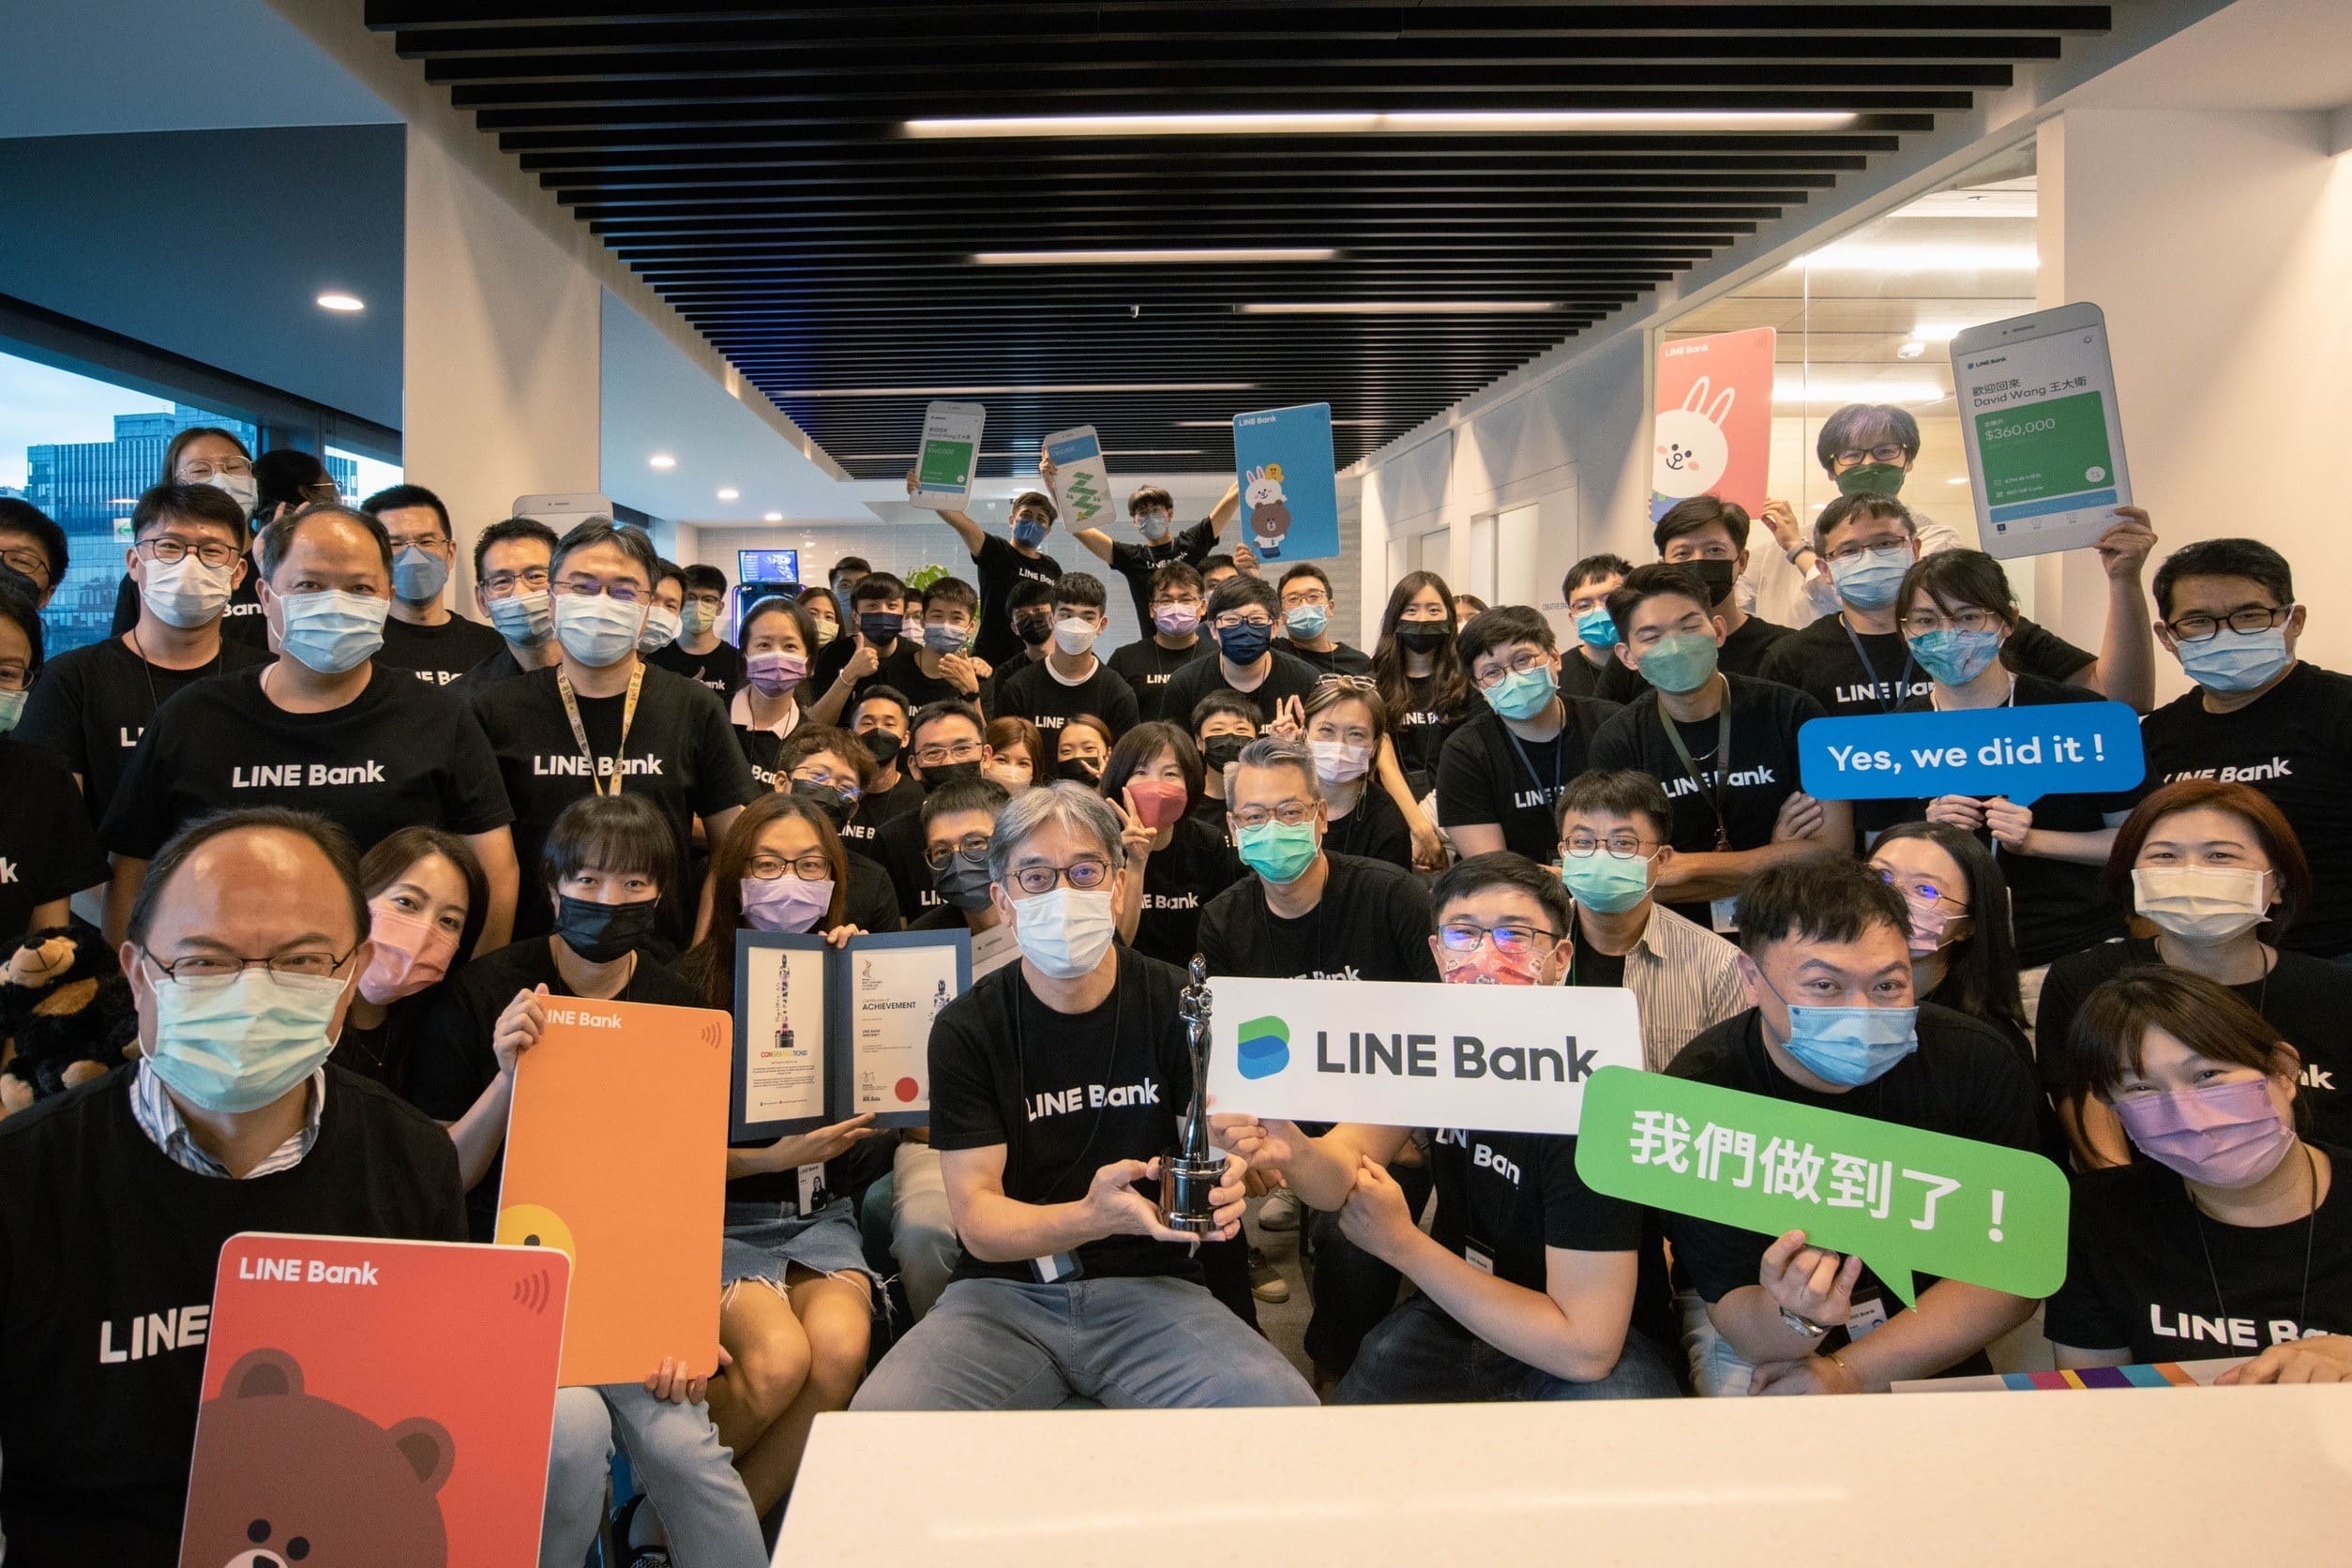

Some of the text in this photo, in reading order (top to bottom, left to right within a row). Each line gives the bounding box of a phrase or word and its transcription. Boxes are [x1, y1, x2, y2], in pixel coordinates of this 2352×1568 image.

[1665, 343, 1711, 357] LINE Bank
[1991, 356, 2007, 365] Bank
[1972, 378, 2021, 397] 歡迎回來
[1973, 376, 2088, 408] David Wang 王大衛
[1238, 415, 1276, 427] LINE Bank
[1984, 418, 2056, 442] $360,000
[1018, 567, 1055, 586] LINE Ban
[1402, 712, 1425, 726] INE
[534, 755, 593, 776] LINE
[1827, 733, 2104, 775] Yes, we did it !
[232, 760, 385, 788] LINE Bank
[1713, 764, 1776, 787] ank
[2220, 756, 2293, 784] Bank
[837, 824, 865, 839] INE
[1154, 892, 1199, 910] Bank
[862, 1002, 916, 1011] ACHIEVEMENT
[546, 1009, 623, 1029] INE Bank
[1317, 1031, 1600, 1083] LINE Bank
[1025, 1077, 1161, 1123] LINE Bank
[1473, 1142, 1521, 1185] Ban
[1629, 1109, 2004, 1243] 我們做到了！
[238, 1257, 379, 1287] LINE Bank
[99, 1304, 210, 1364] LINE
[2149, 1303, 2258, 1349] LINE
